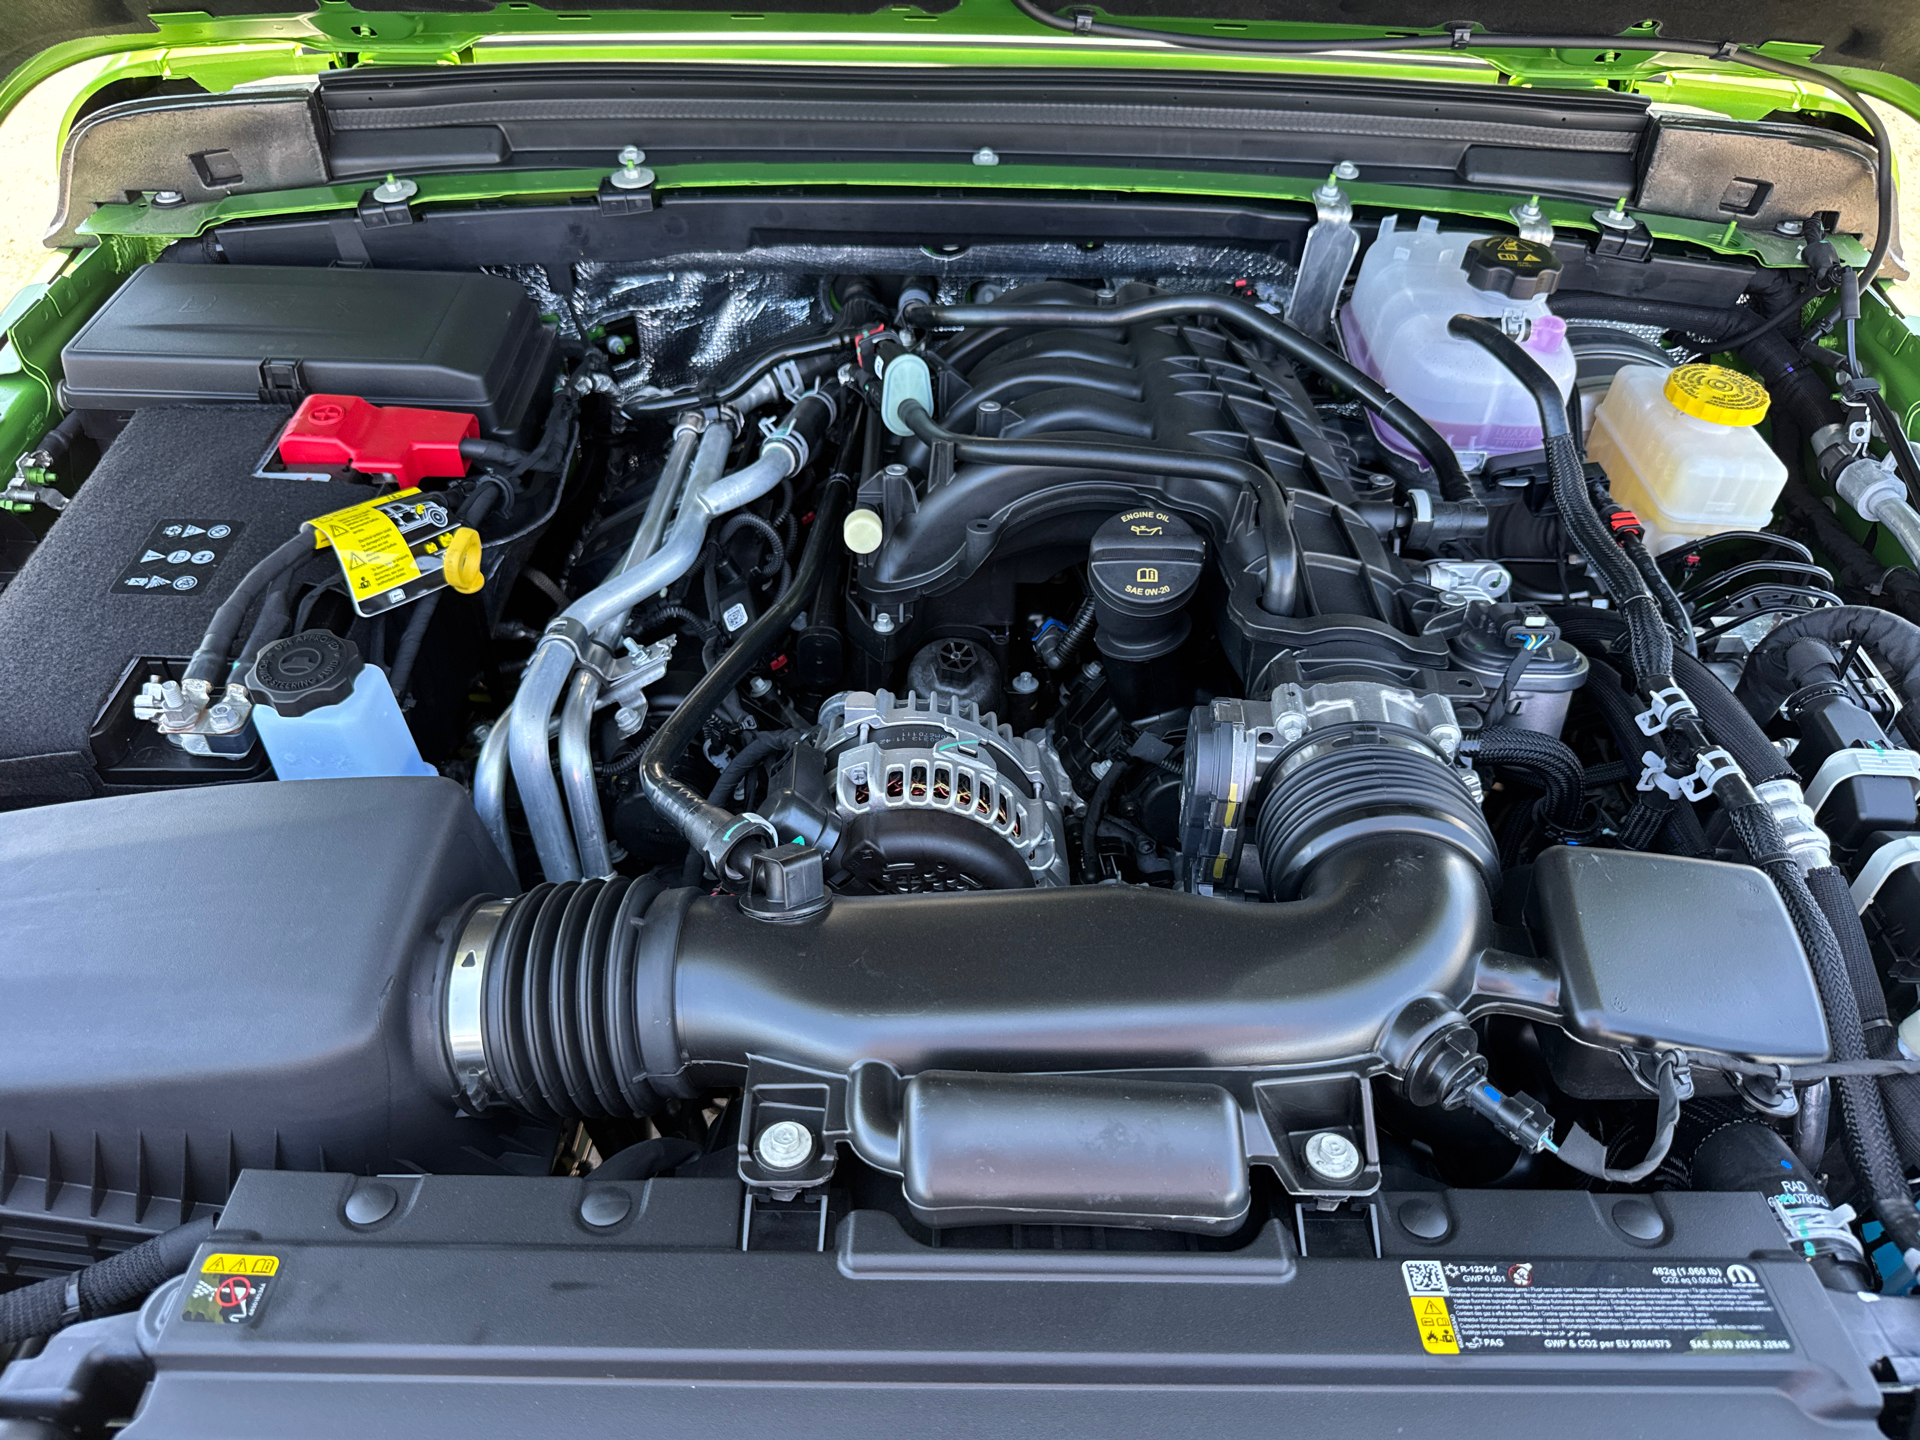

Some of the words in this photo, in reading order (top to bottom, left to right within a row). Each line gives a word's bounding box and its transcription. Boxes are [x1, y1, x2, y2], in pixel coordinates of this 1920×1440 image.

[1120, 511, 1154, 522] ENGINE
[1156, 513, 1170, 523] OIL
[1125, 584, 1144, 596] SAE
[1144, 585, 1170, 596] 0W-20
[274, 640, 292, 651] USE
[296, 634, 340, 651] APPROVED
[259, 660, 272, 682] POWER
[271, 676, 316, 690] STEERING
[318, 660, 339, 679] FLUID
[1781, 1180, 1808, 1192] RAD
[1460, 1264, 1498, 1274] R-1234yf
[1652, 1266, 1676, 1277] 482g
[1484, 1338, 1504, 1347] PAG
[1544, 1339, 1567, 1348] GWP
[1568, 1340, 1576, 1348] &
[1578, 1340, 1598, 1348] CO2
[1600, 1341, 1615, 1350] per
[1616, 1340, 1630, 1348] EU
[1631, 1340, 1672, 1349] 2024/573
[1690, 1340, 1710, 1349] SAE
